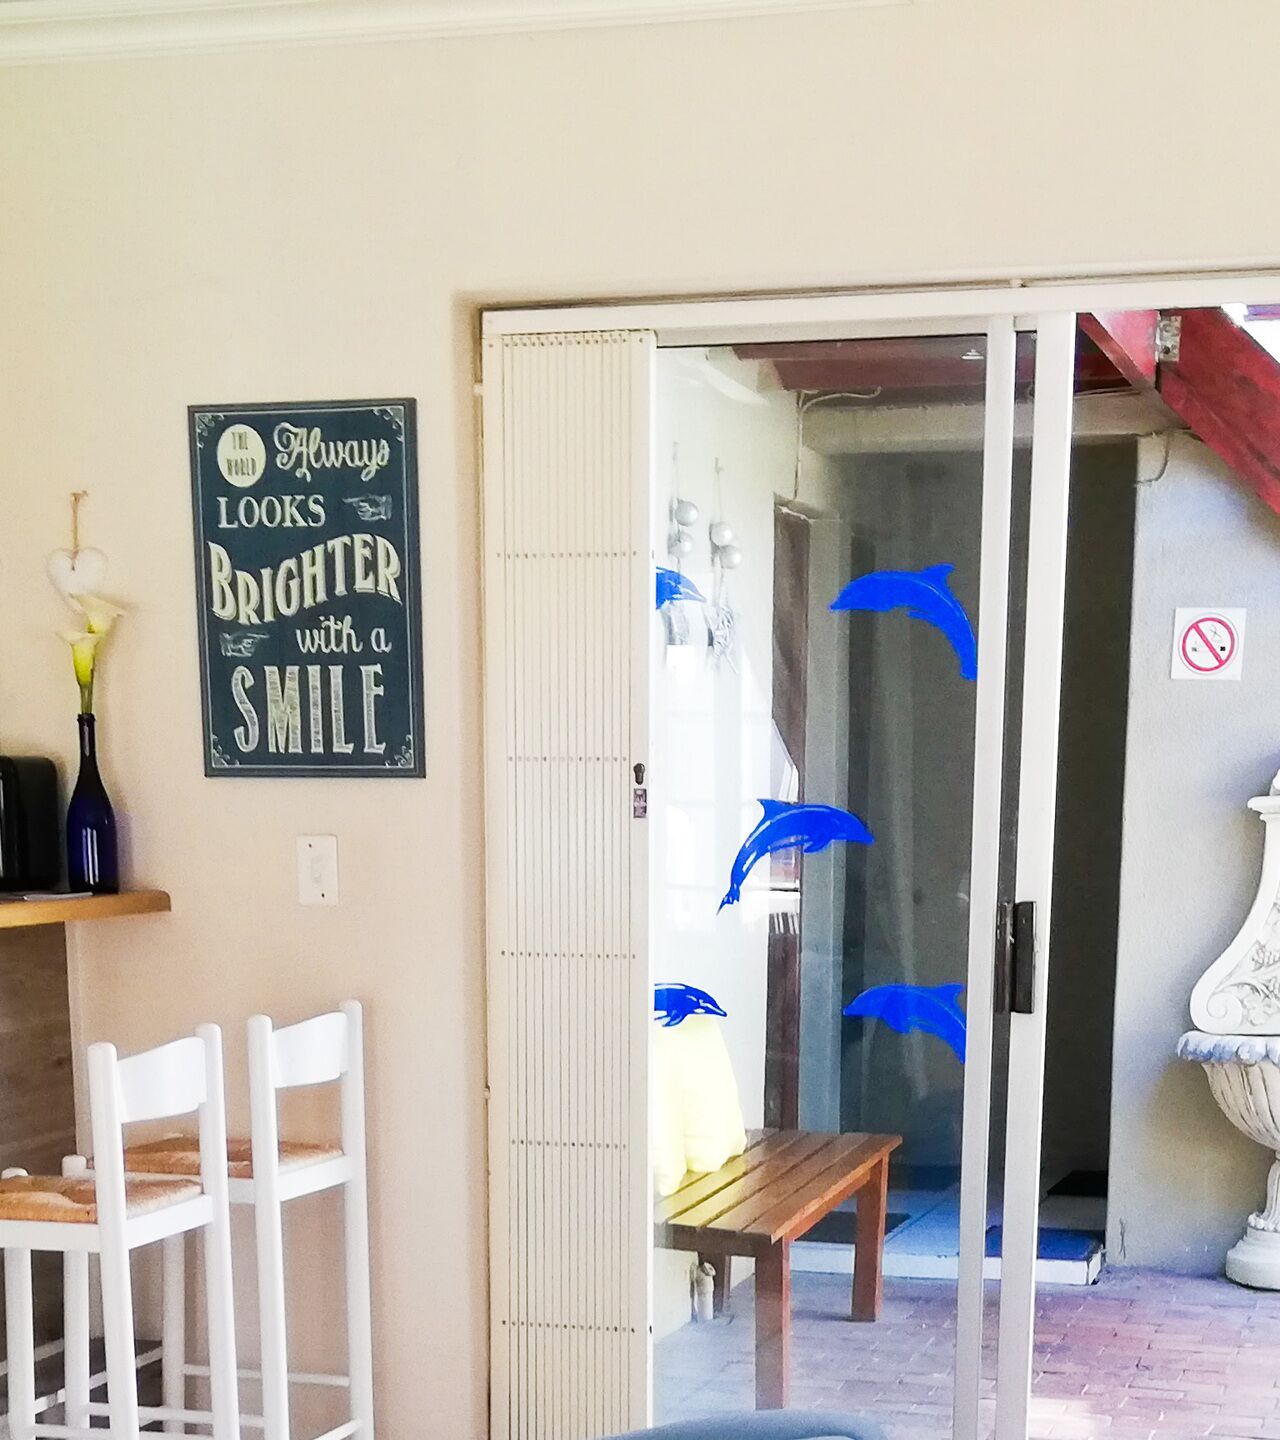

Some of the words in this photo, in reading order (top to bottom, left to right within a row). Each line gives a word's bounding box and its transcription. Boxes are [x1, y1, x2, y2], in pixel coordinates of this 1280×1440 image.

[231, 431, 249, 450] THE
[273, 421, 391, 483] Always
[226, 457, 257, 477] WORLD
[216, 494, 326, 528] LOOKS
[207, 533, 402, 626] BRIGHTER
[296, 615, 363, 654] with
[370, 628, 392, 653] a
[231, 663, 387, 755] SMILE
